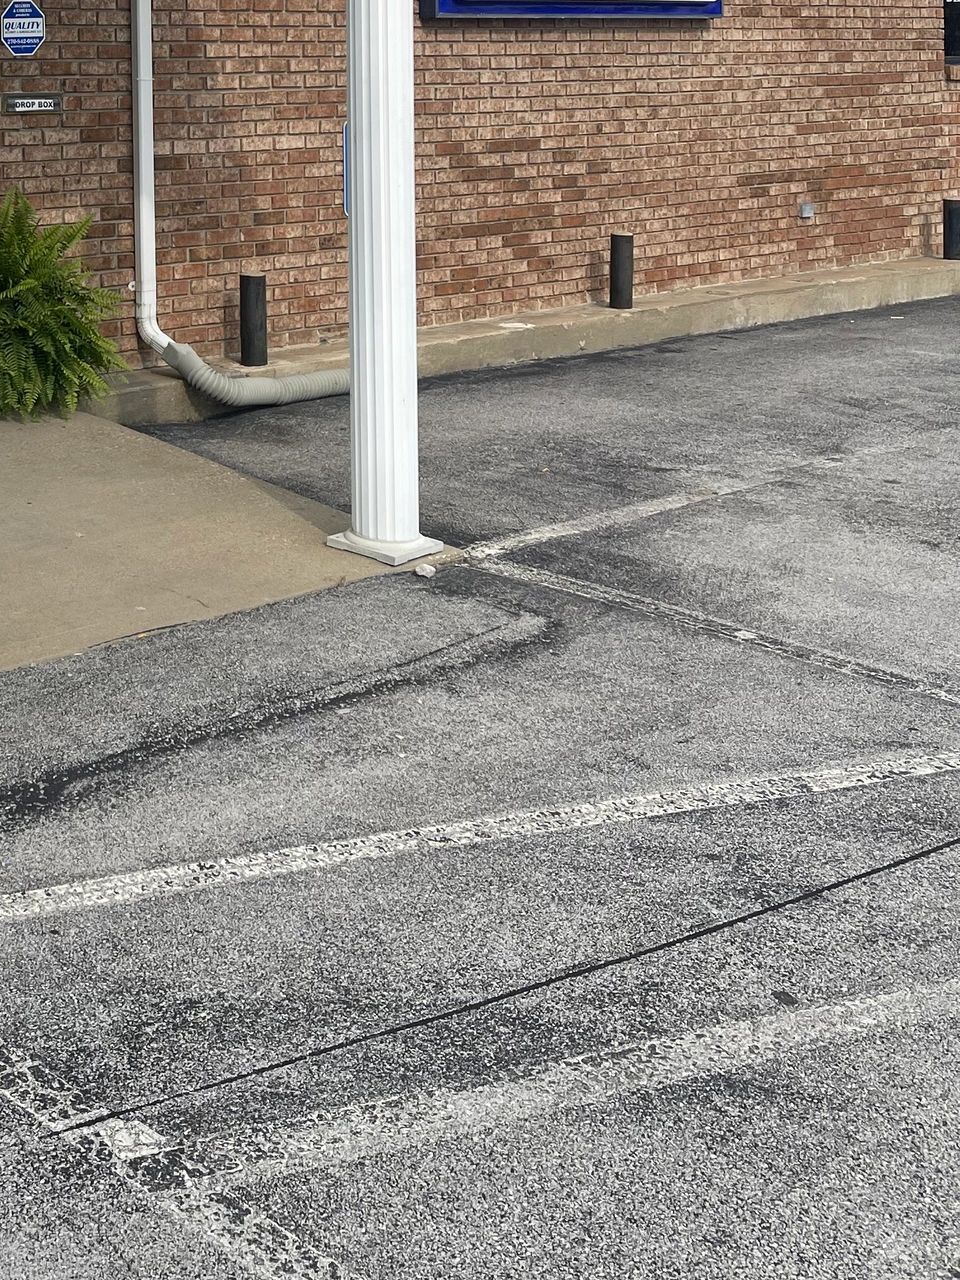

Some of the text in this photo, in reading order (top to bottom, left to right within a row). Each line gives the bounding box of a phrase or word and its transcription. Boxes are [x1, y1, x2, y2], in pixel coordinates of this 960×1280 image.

[4, 21, 41, 31] QUALITY
[15, 100, 53, 109] DROP BOX
